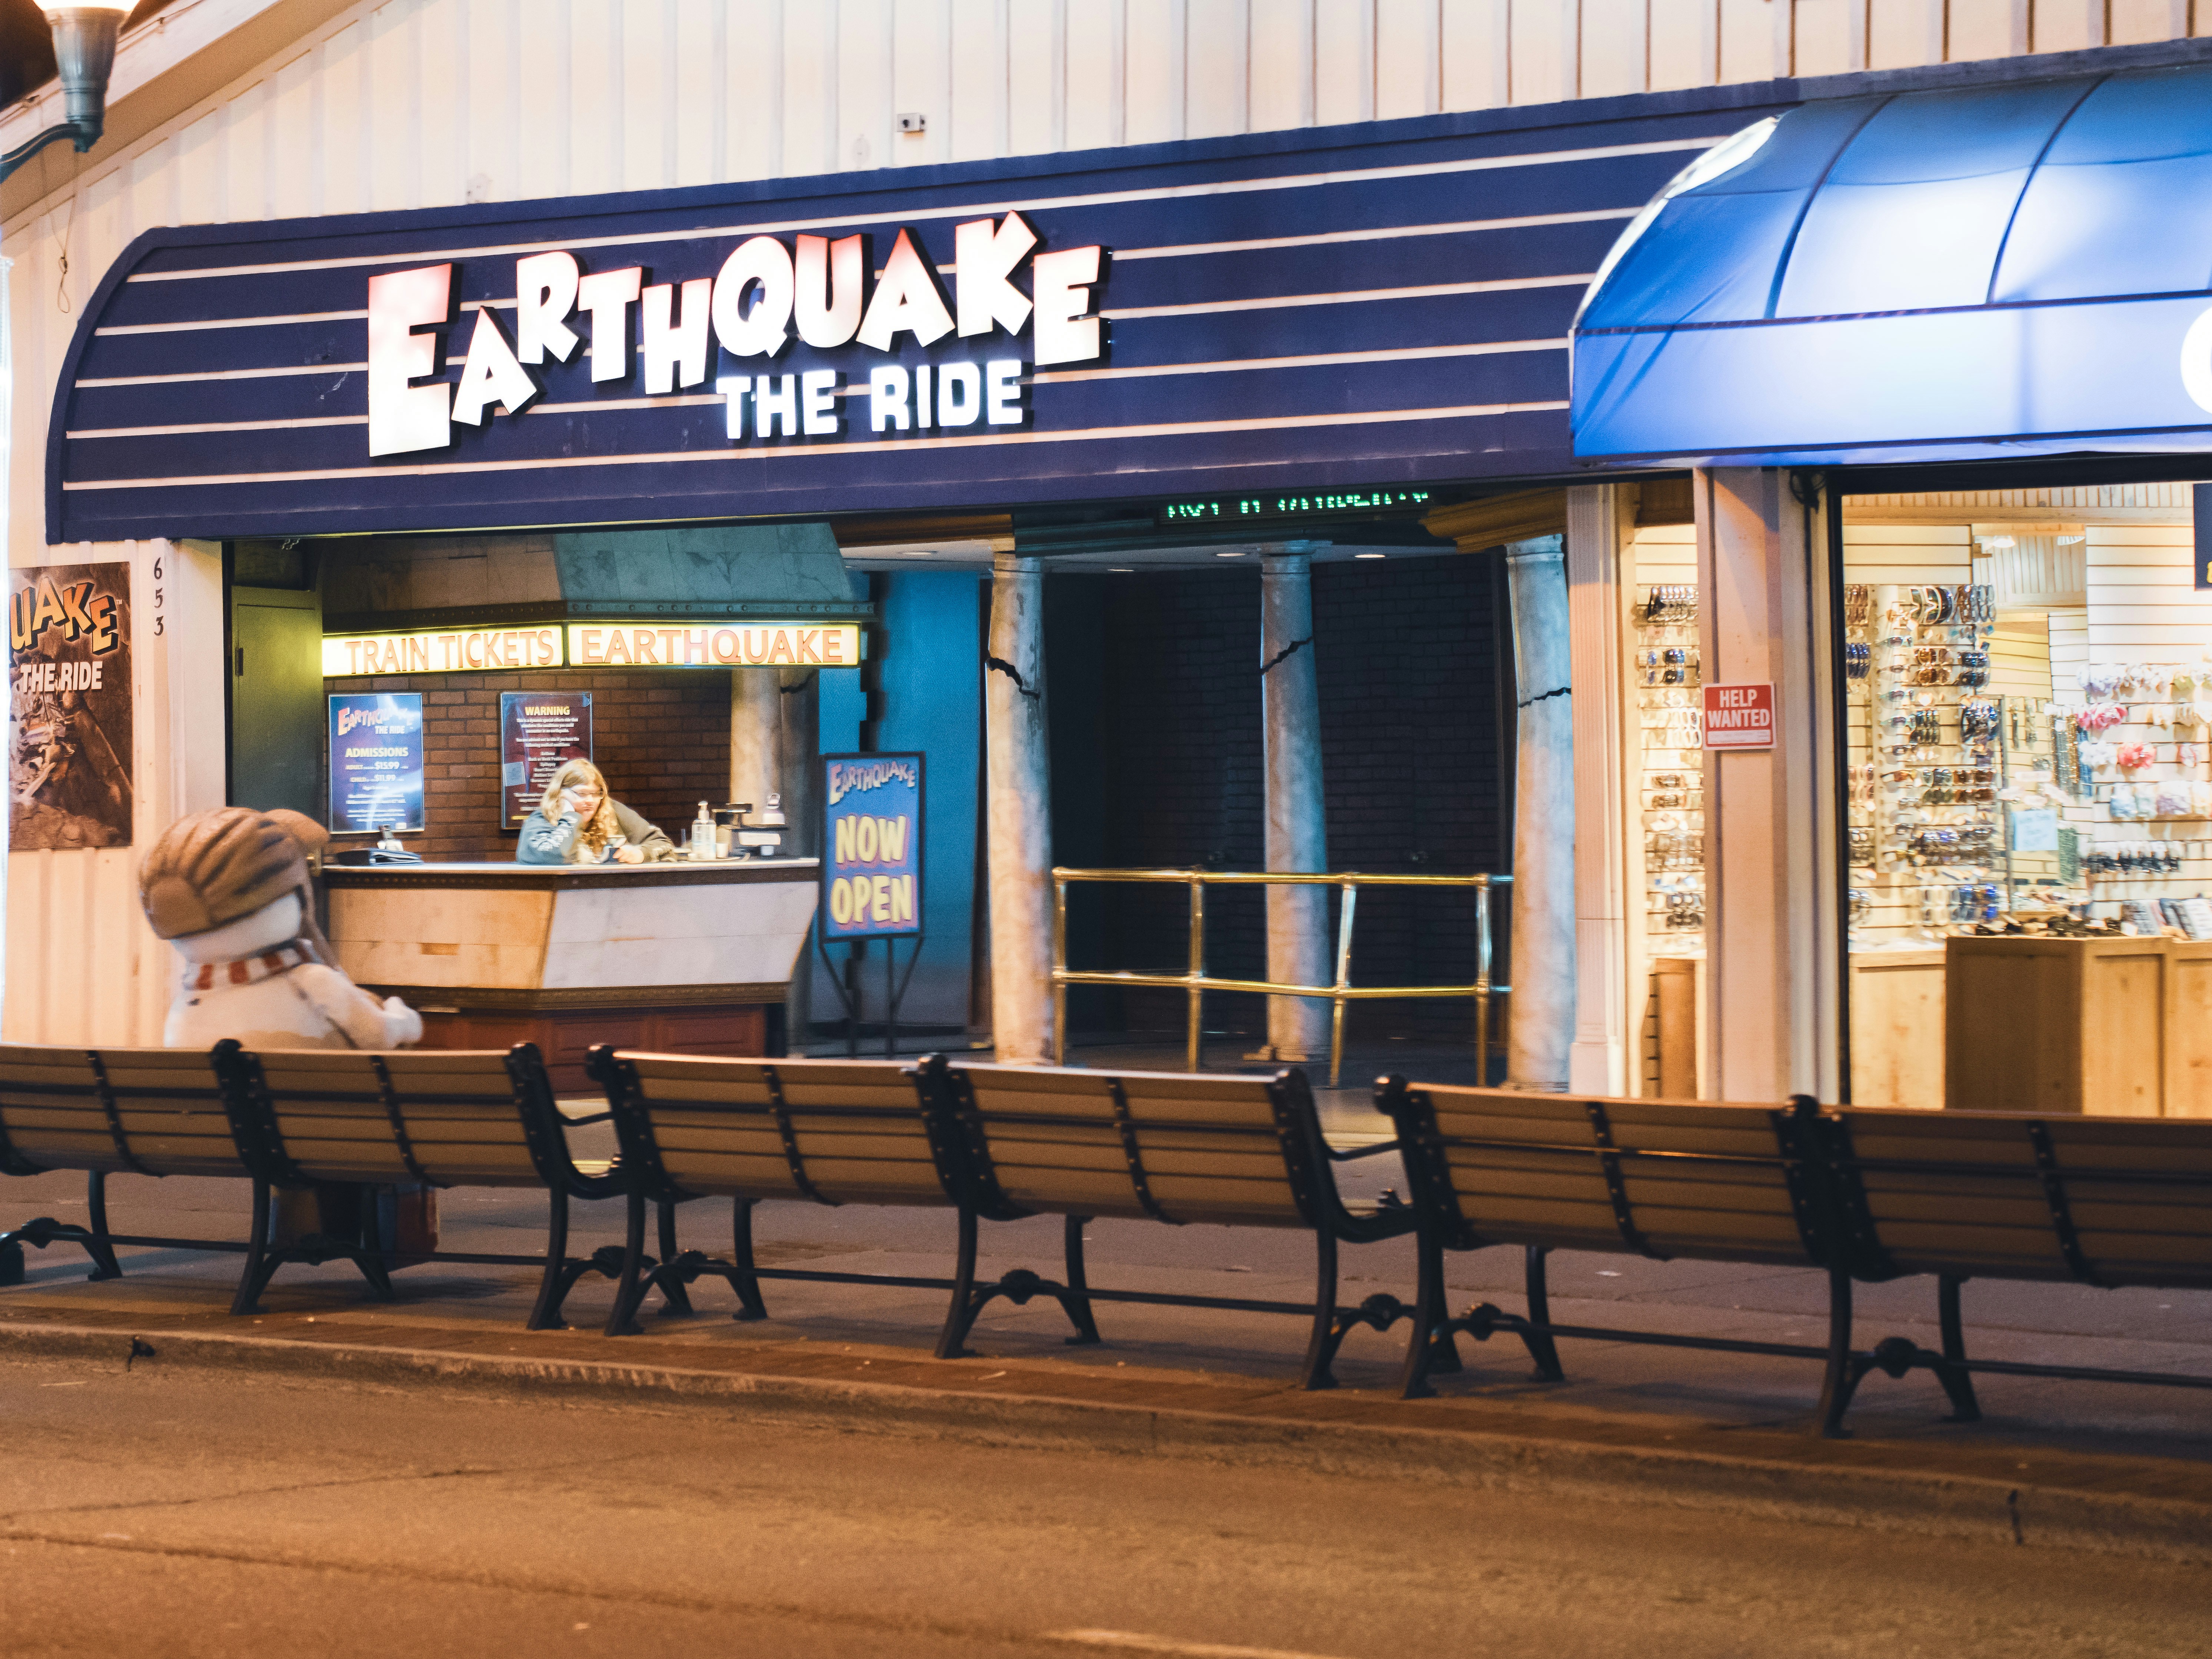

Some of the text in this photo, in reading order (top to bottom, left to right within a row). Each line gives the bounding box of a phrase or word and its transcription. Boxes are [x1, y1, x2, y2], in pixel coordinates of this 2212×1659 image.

[368, 210, 1102, 456] EARTHQUAKE
[716, 359, 1023, 439] THE RIDE
[345, 630, 554, 674] TRAIN TICKETS
[582, 630, 842, 664] EARTHQUAKE
[20, 661, 103, 693] THE RIDE
[525, 706, 571, 716] WARNING
[1719, 689, 1757, 708] HELP
[375, 725, 405, 734] THE RIDE
[1707, 709, 1770, 728] WANTED
[345, 747, 409, 758] ADMISSIONS
[829, 761, 915, 805] EARTHQUAKE
[836, 815, 907, 864] NOW
[830, 874, 912, 925] OPEN
